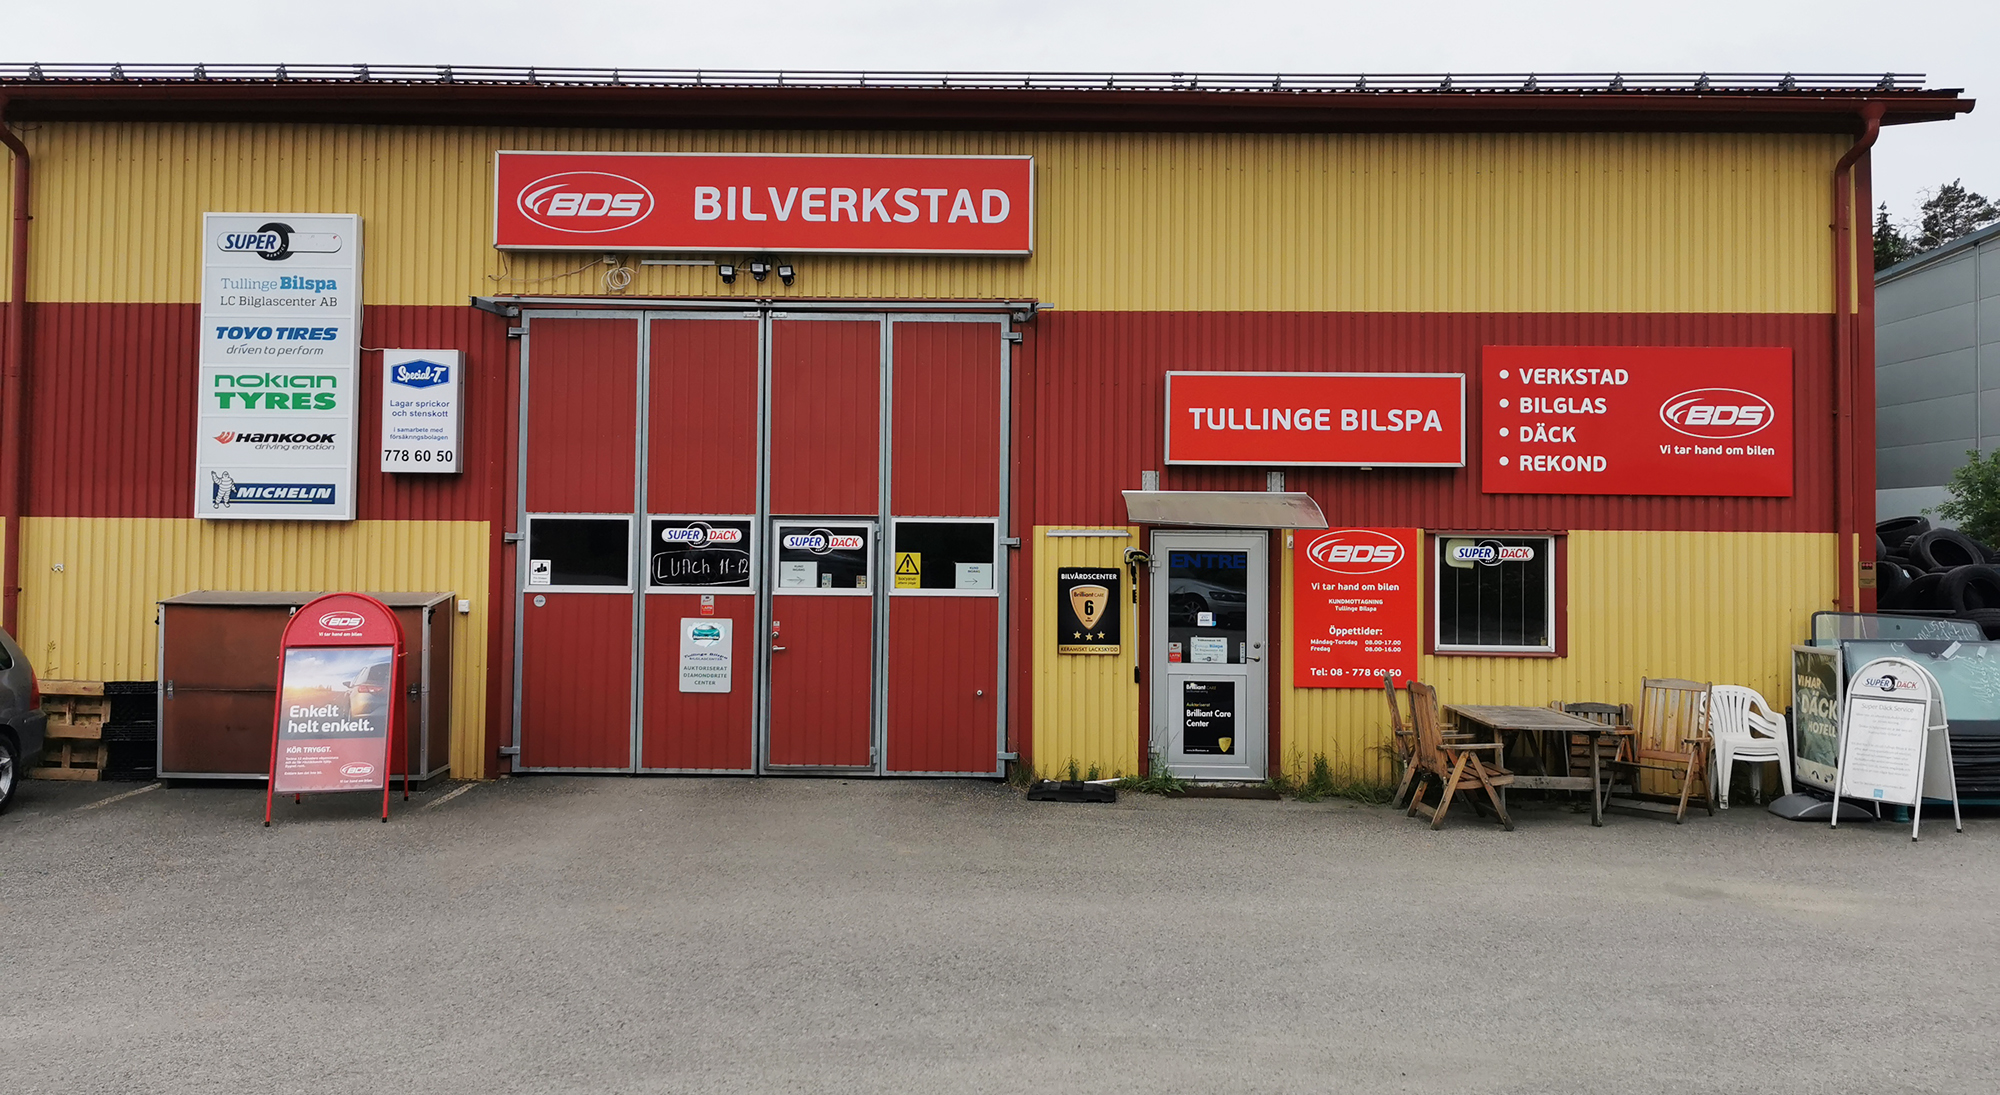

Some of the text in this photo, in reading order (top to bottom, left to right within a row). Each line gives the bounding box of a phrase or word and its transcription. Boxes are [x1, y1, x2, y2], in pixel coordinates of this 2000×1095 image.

[547, 193, 645, 217] BDS
[694, 186, 1010, 224] BILVERKSTAD
[225, 234, 276, 250] SUPER
[221, 275, 337, 293] Tullinge Bilspa
[220, 295, 338, 308] LC Bilglascenter AB
[216, 326, 338, 341] TOYO TIRES
[226, 343, 324, 357] driven to perform
[1519, 368, 1629, 385] VERKSTAD
[214, 392, 337, 410] TYRES
[390, 400, 450, 408] Lagar sprickor
[1519, 397, 1607, 414] BILGLAS
[1188, 407, 1443, 432] TULLINGE BILSPA
[1684, 405, 1766, 426] BDS
[1519, 423, 1577, 443] DÄCK
[255, 443, 289, 451] driving
[1660, 445, 1775, 456] Vi tar hand om bilen
[384, 450, 453, 462] 778 60 50
[1519, 456, 1607, 472] REKOND
[236, 486, 332, 499] MICHELIN
[668, 530, 700, 540] SUPER
[709, 530, 738, 540] DÄCK
[789, 536, 859, 547] SUPER DÄCK
[1328, 545, 1398, 563] BDS
[1458, 548, 1530, 558] SUPER DÄCK
[720, 558, 749, 575] 11-12
[1171, 554, 1246, 569] ENTRE
[1061, 572, 1117, 580] BILVÅRDSCENTER
[1322, 583, 1336, 591] tar
[1338, 583, 1360, 591] hand
[1377, 583, 1400, 591] bilen
[1084, 600, 1094, 616] 6
[328, 617, 362, 626] BDS
[1329, 625, 1383, 637] Öppettider:
[1310, 668, 1328, 676] Tel:
[1330, 668, 1343, 676] 08
[1352, 669, 1371, 677] 778
[1373, 669, 1386, 677] 60
[1389, 669, 1402, 677] 50
[1805, 676, 1821, 689] HAR
[1865, 678, 1918, 689] SUPER DÄCK
[289, 705, 339, 718] Enkelt
[1801, 691, 1837, 720] DÄCK
[1186, 709, 1232, 718] Brilliant Care
[287, 719, 374, 733] helt enkelt.
[1186, 719, 1210, 727] Center
[1808, 721, 1837, 737] HOTELL
[286, 745, 302, 754] KÖR
